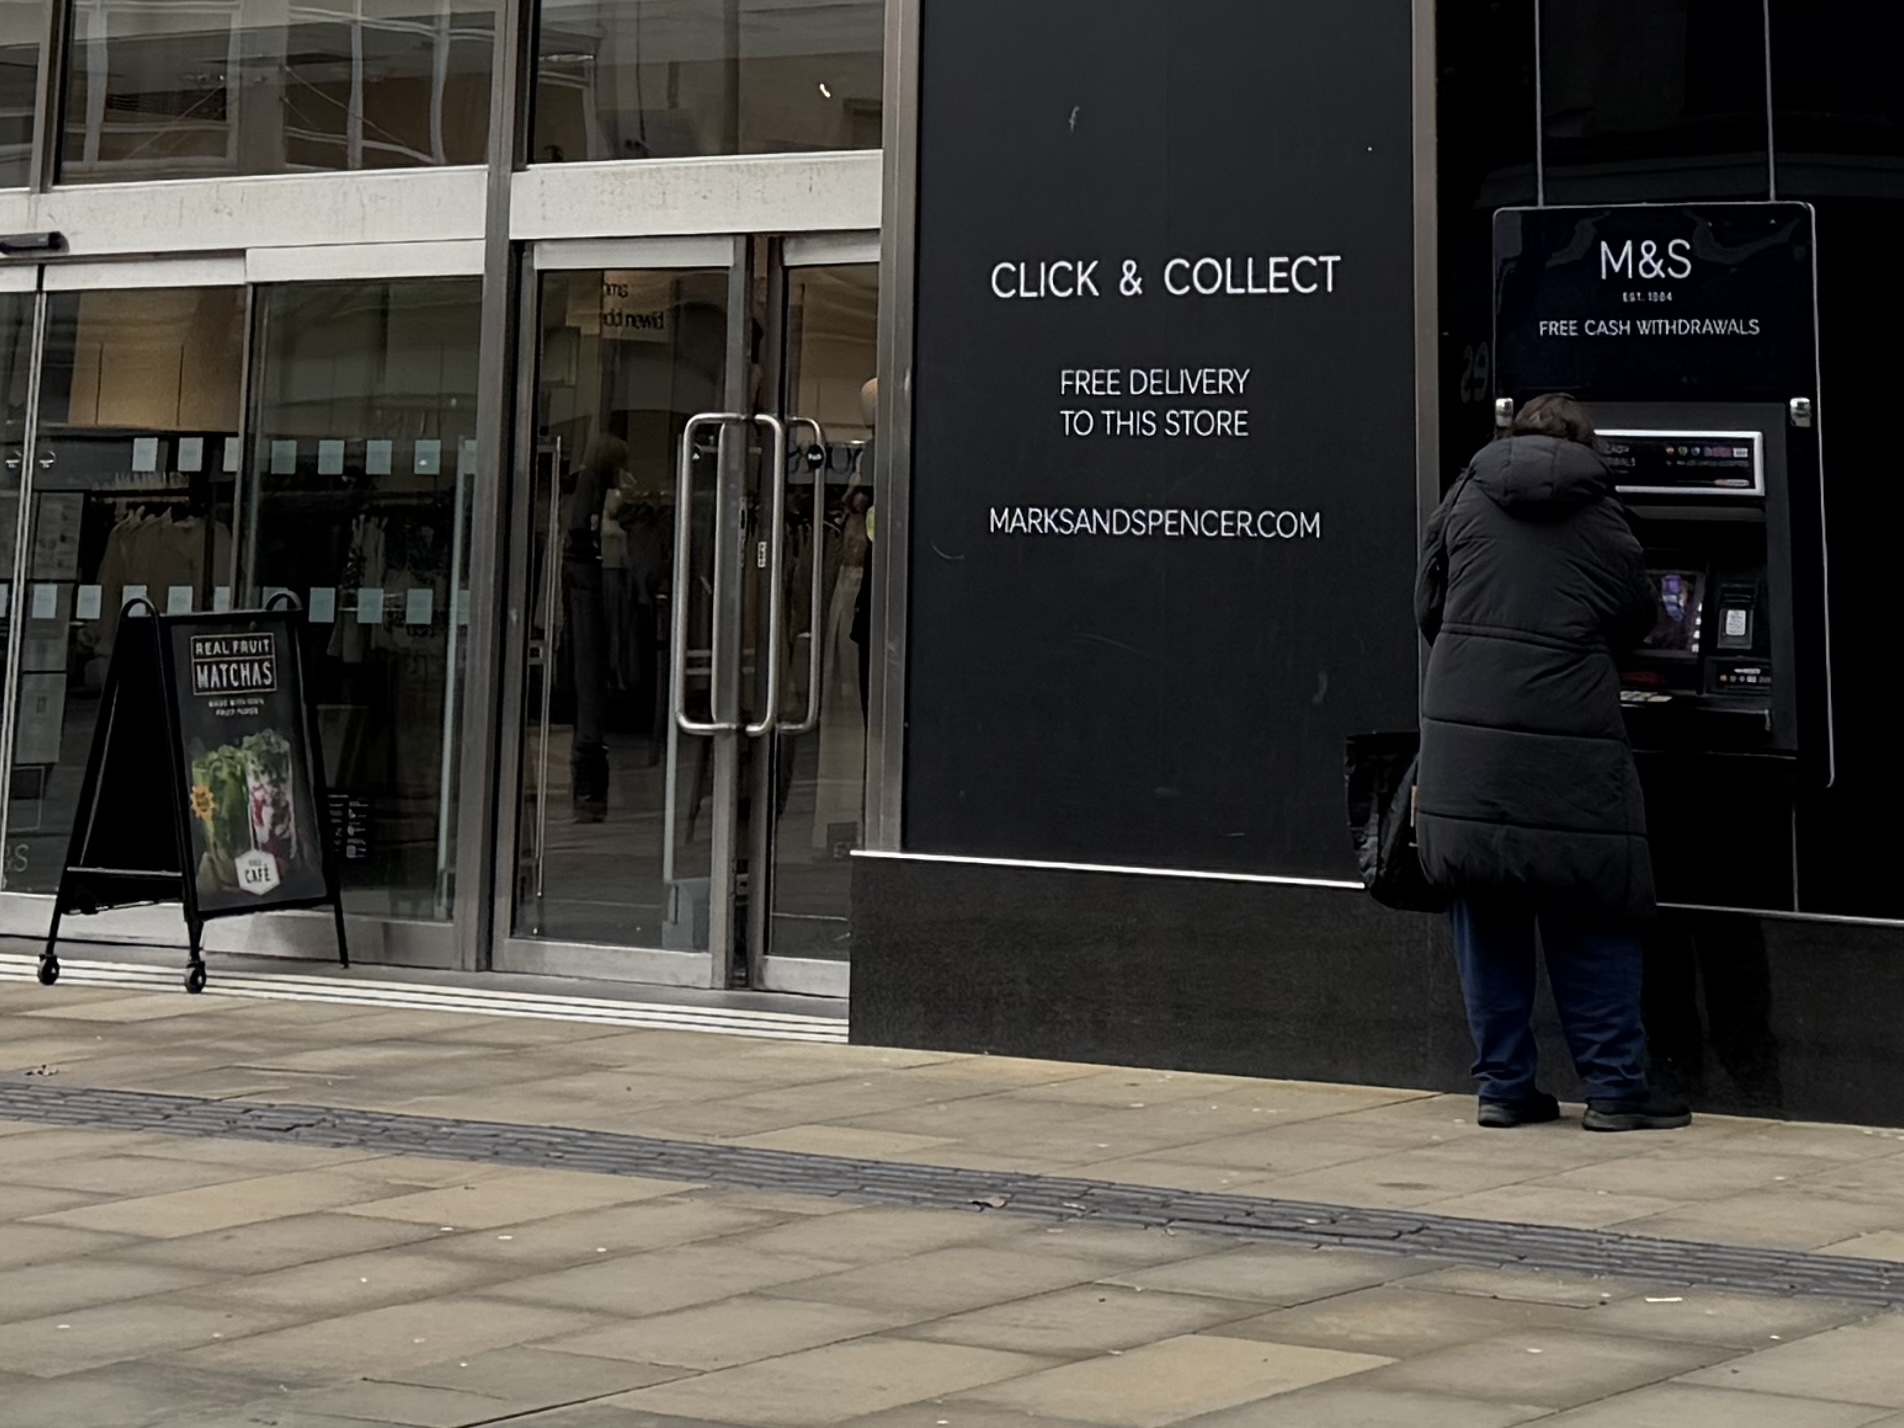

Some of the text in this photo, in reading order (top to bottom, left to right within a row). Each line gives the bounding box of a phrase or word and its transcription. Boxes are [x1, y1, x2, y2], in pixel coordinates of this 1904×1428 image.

[1599, 238, 1693, 281] M&S
[990, 254, 1342, 298] CLICK & COLLECT
[1538, 317, 1761, 337] FREE CASH WITHDRAWALS
[1060, 367, 1251, 396] FREE DELIVERY
[1060, 409, 1250, 438] TO THIS STORE
[989, 507, 1321, 540] MARKSANDSPENCER.COM
[194, 638, 271, 656] REAL FRUIT
[195, 660, 274, 689] MATCHAS
